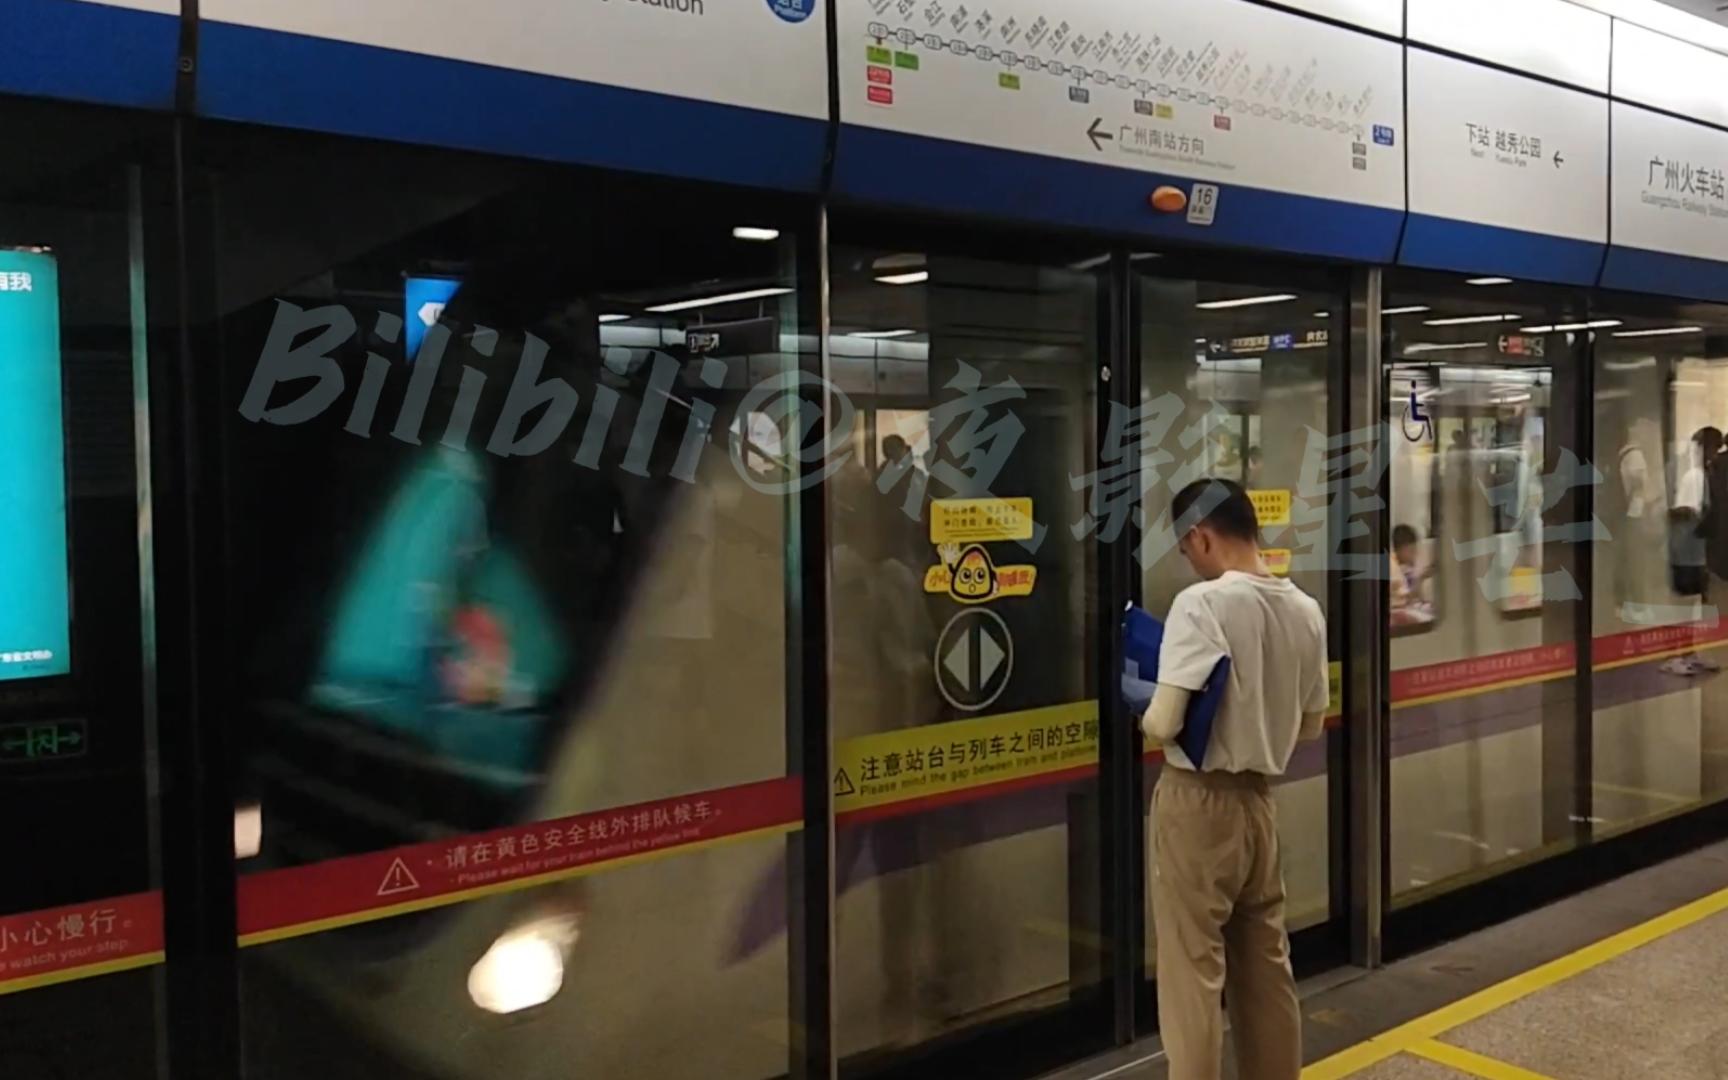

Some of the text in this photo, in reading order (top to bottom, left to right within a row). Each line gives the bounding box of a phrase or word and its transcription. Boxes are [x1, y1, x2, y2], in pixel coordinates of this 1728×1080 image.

[1119, 124, 1205, 155] 广州南站方向
[1465, 122, 1542, 159] 下站 越秀公园
[1647, 155, 1725, 201] 广州火车站
[1197, 187, 1213, 206] 16
[860, 782, 898, 797] Please
[930, 772, 947, 783] the
[951, 768, 970, 783] gap
[973, 760, 1013, 775] between
[446, 800, 723, 869] 请在黄色安全线外排队候车。
[458, 870, 498, 884] Please
[10, 951, 57, 970] watch
[60, 945, 93, 962] your
